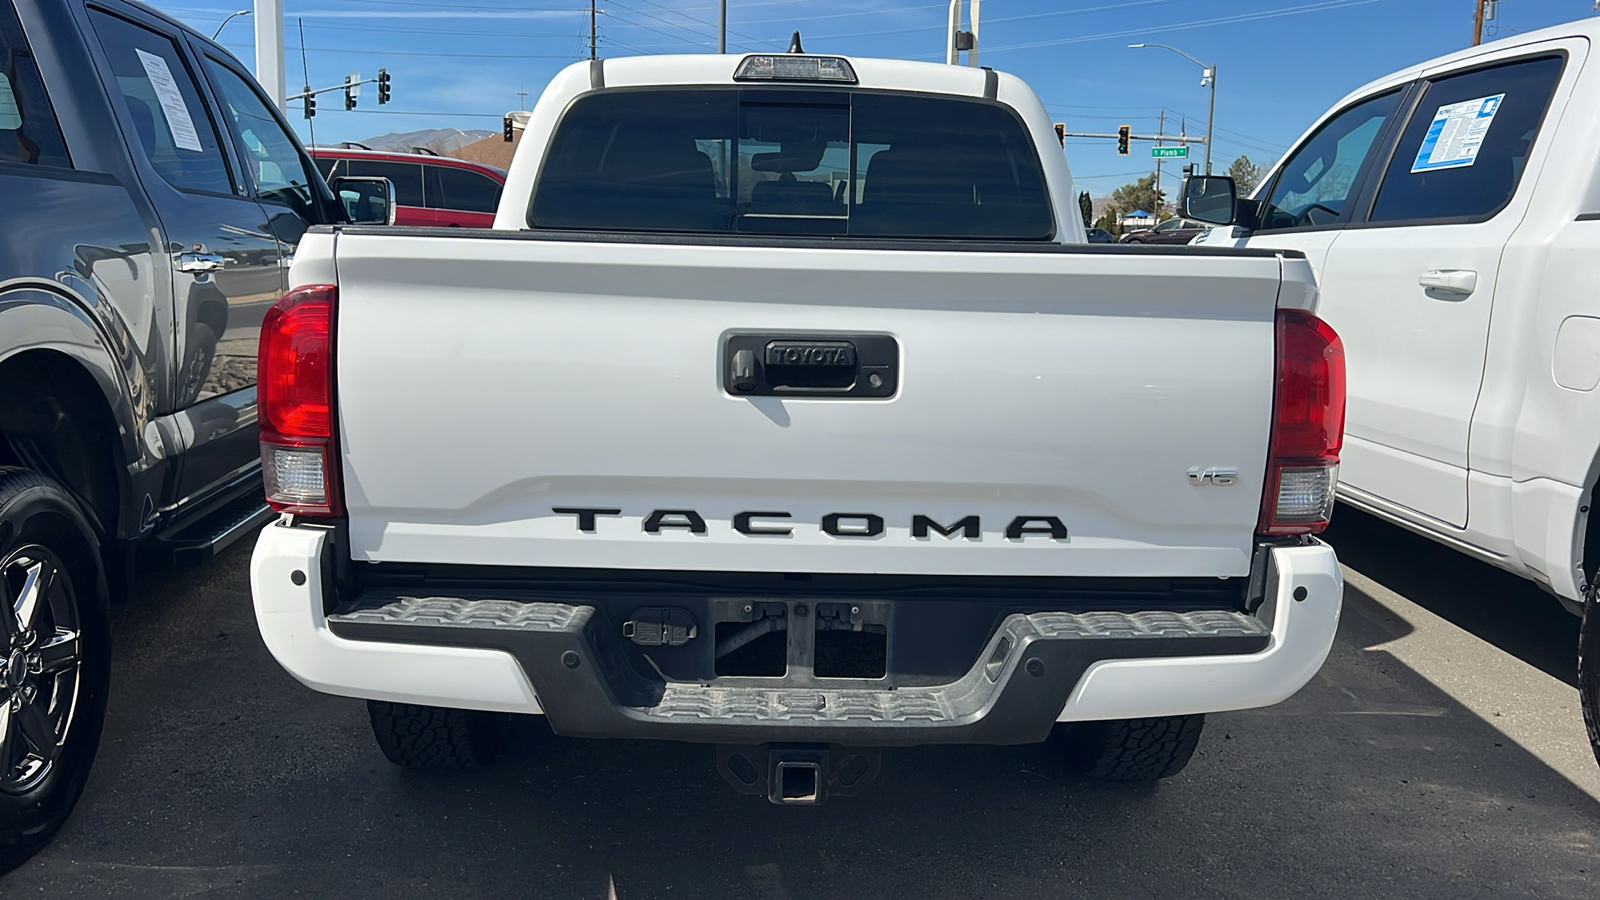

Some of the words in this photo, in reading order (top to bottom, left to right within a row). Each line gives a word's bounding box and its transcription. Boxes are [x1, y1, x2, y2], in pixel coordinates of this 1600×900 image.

[1160, 149, 1178, 157] Plumb
[773, 347, 849, 365] TOYOTA
[1186, 467, 1239, 487] V6
[551, 506, 1070, 543] TACOMA
